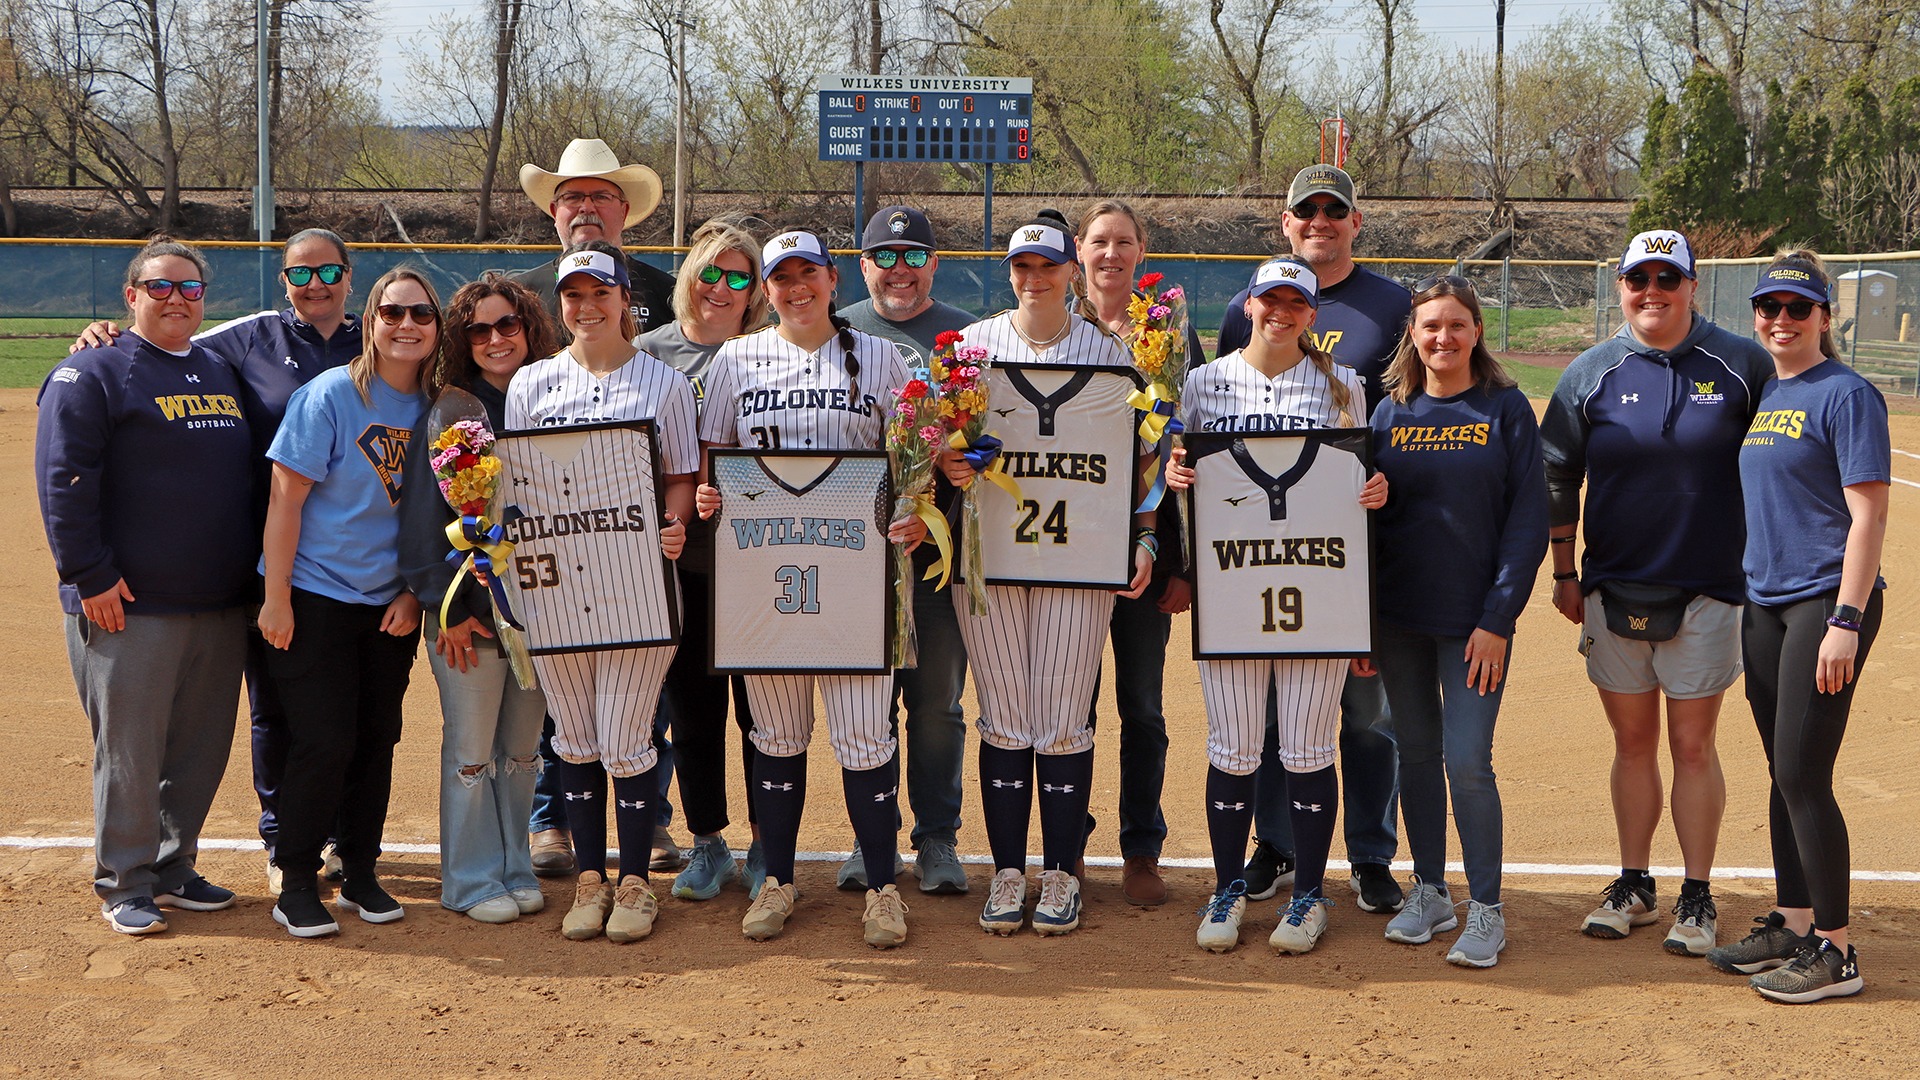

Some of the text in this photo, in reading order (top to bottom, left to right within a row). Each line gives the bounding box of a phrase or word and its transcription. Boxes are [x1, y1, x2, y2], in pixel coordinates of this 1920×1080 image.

[841, 78, 1010, 91] WILKES UNIVERSITY
[829, 94, 1017, 112] BALL 0 STRIKE 0 OUT 0 H/E
[873, 117, 1029, 128] 1 2 3 4 5 6 7 8 9 RUNS
[829, 126, 1027, 142] GUEST 0
[829, 143, 1027, 159] HOME 0
[778, 236, 798, 249] W
[1024, 229, 1043, 242] W
[1642, 237, 1677, 255] W
[573, 255, 593, 266] W
[1280, 266, 1301, 279] W
[1769, 269, 1810, 281] COLONELS
[1695, 381, 1715, 394] W
[742, 388, 877, 418] COLONELS
[1690, 393, 1724, 402] WILKES
[154, 394, 243, 421] WILKES
[187, 419, 235, 430] SOFTBALL
[1747, 409, 1806, 439] ILKES
[386, 428, 412, 439] WILKE
[1391, 423, 1490, 447] WILKES
[1401, 443, 1464, 452] SOFTBALL
[377, 463, 392, 485] IRON
[503, 504, 644, 545] COLONELS
[1015, 499, 1068, 544] 24
[731, 517, 865, 551] WILKES
[1212, 536, 1346, 571] WILKES
[515, 552, 560, 590] 53
[774, 565, 820, 614] 31
[1261, 586, 1303, 633] 19
[1628, 615, 1648, 631] W
